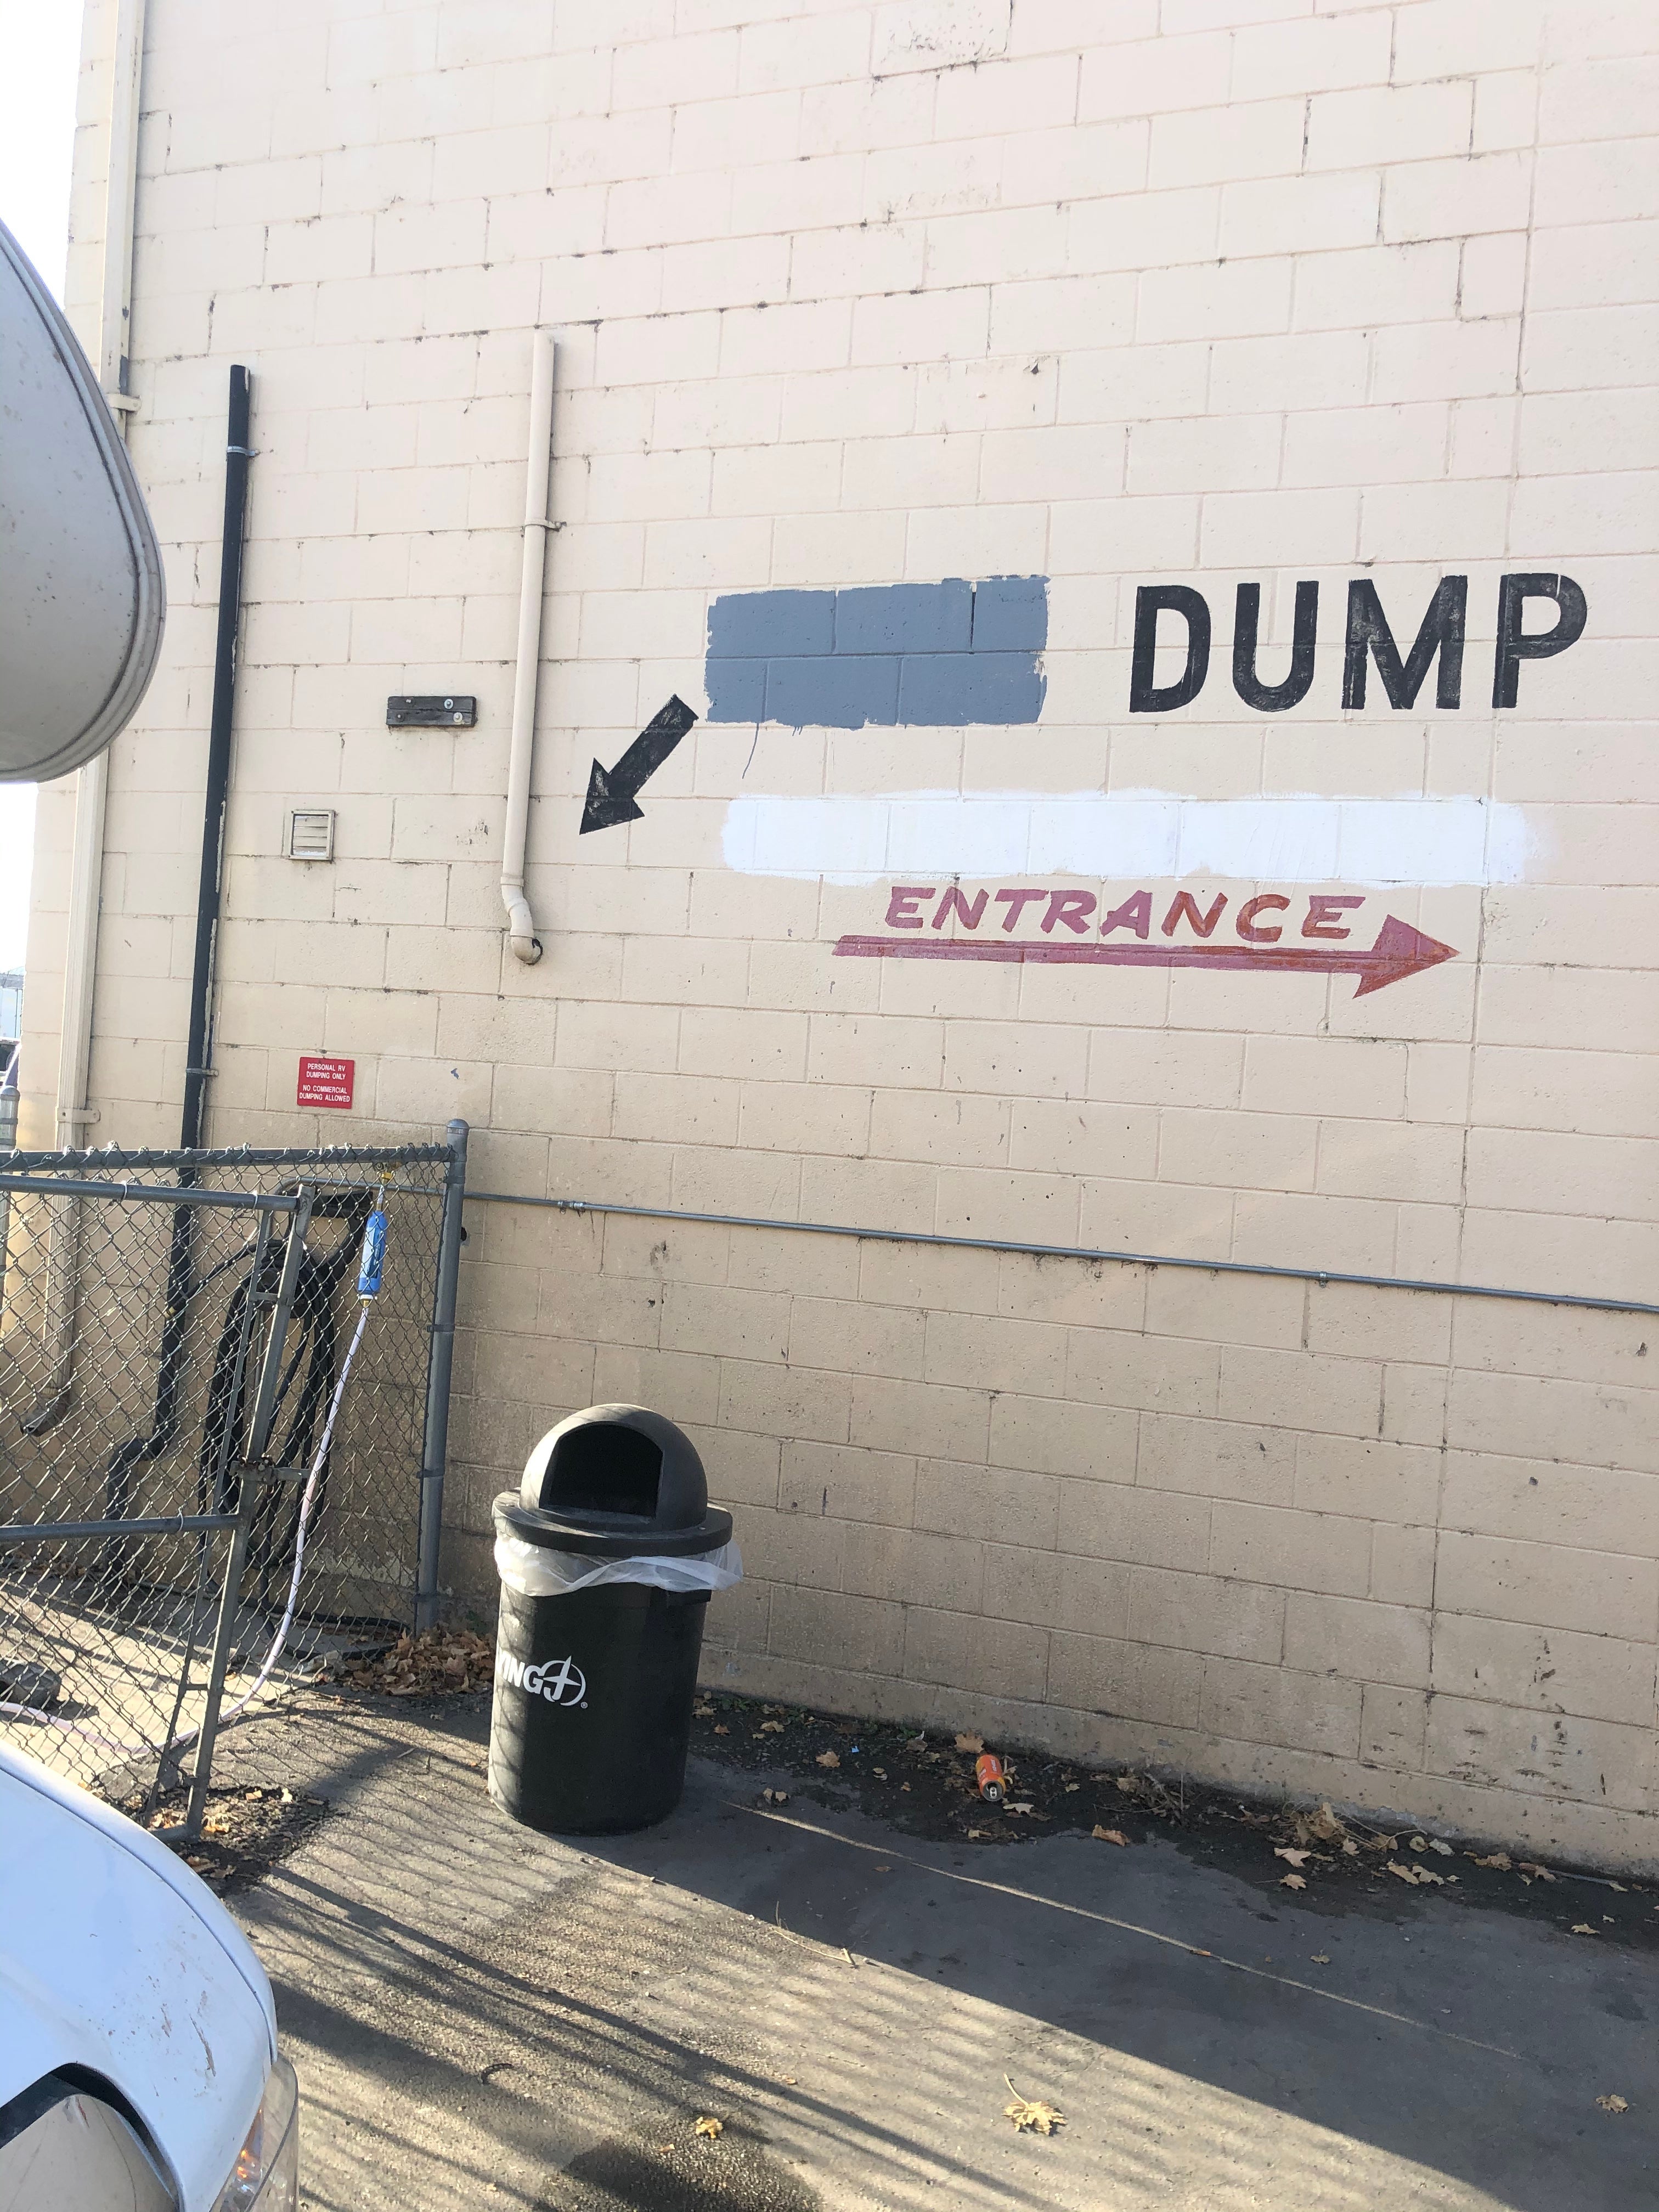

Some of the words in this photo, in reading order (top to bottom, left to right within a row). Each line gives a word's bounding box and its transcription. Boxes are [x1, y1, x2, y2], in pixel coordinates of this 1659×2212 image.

[1128, 572, 1588, 714] DUMP
[884, 886, 1367, 941] ENTRANCE
[307, 1063, 336, 1071] PERSONAL
[313, 1086, 347, 1094] COMMERCIAL
